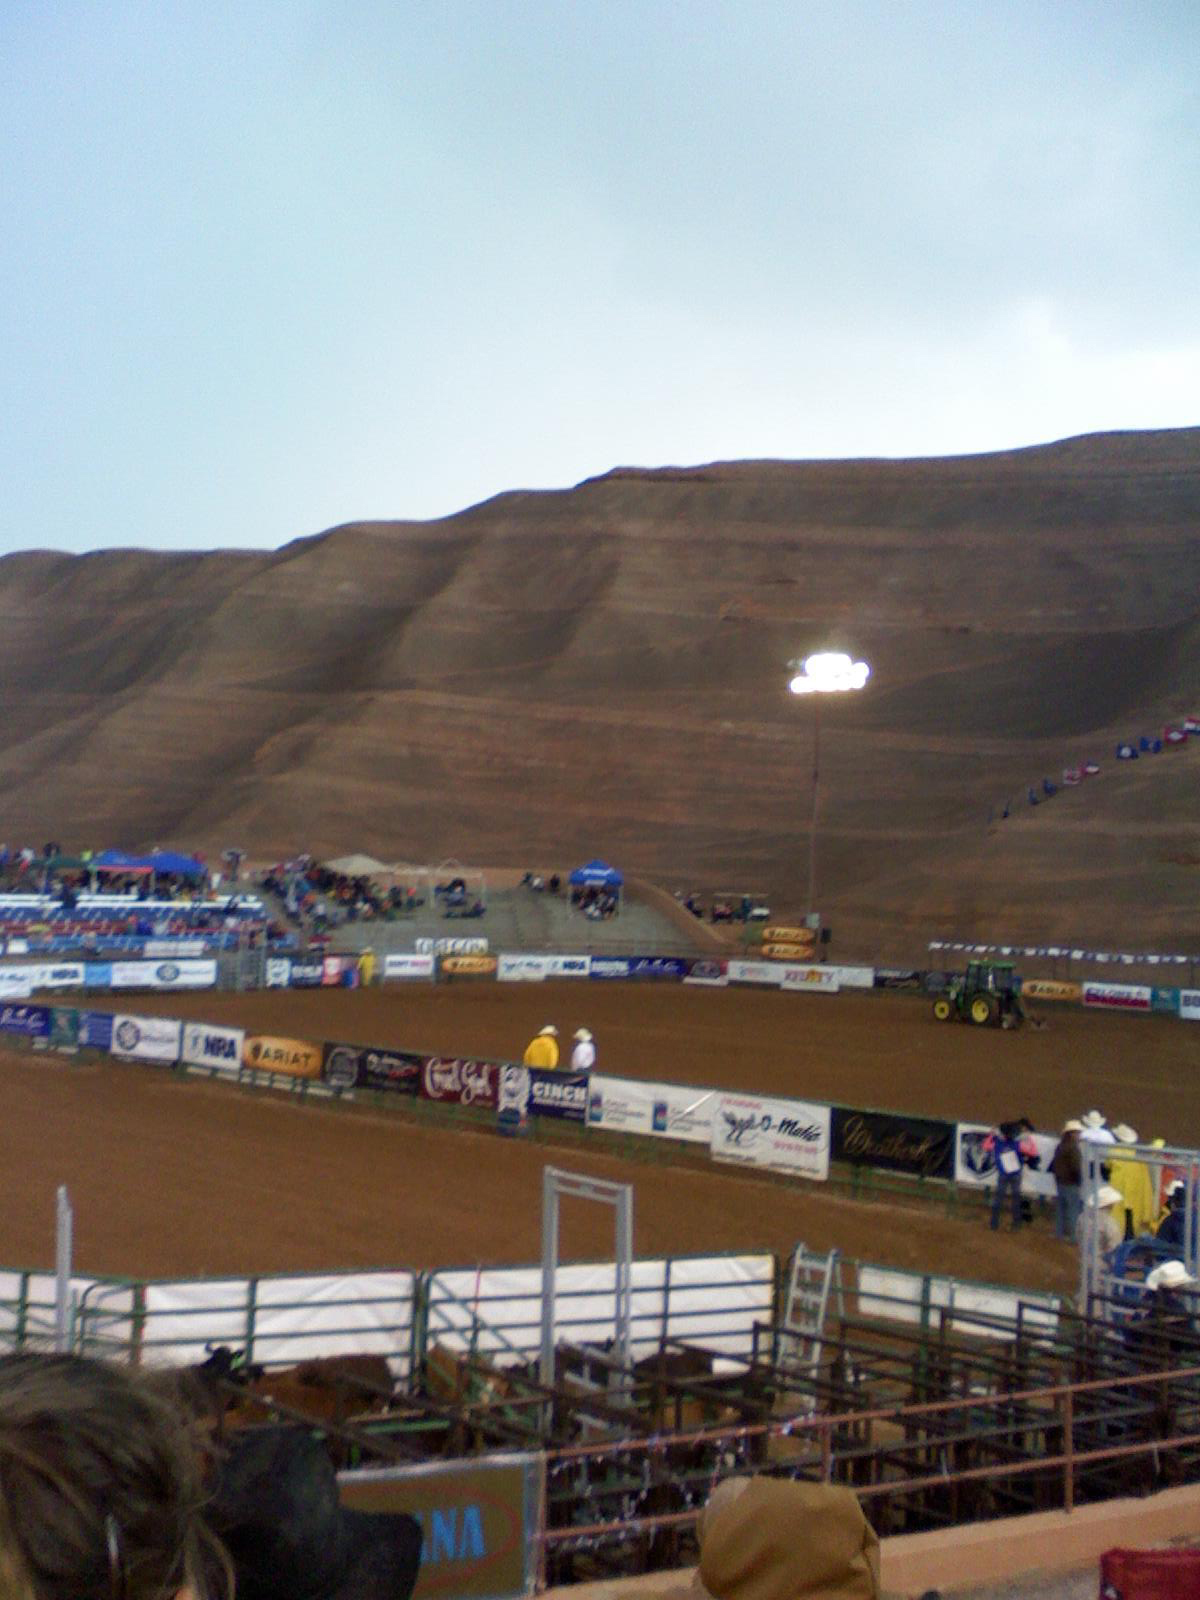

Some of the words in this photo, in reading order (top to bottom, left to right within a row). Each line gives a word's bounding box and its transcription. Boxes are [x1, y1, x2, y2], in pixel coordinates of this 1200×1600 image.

[204, 1034, 237, 1060] NRA
[262, 1047, 312, 1067] ARIAT
[532, 1081, 587, 1101] CINCH
